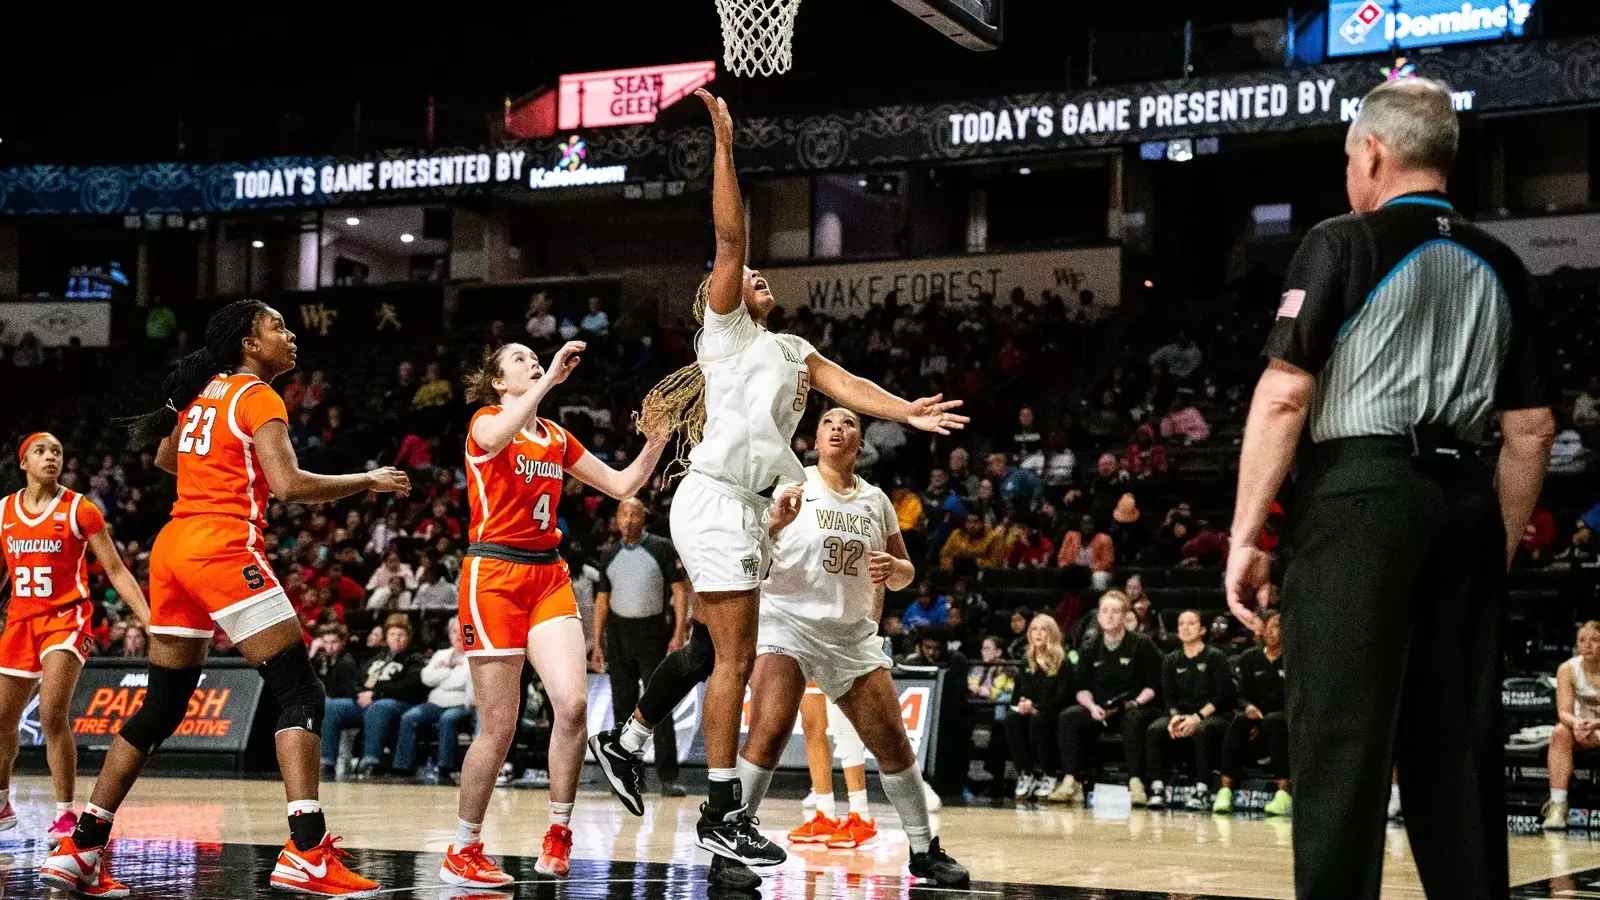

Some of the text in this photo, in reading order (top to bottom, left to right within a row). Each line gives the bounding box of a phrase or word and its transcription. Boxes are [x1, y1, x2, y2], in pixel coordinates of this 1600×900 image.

[1384, 0, 1532, 41] Domino's
[613, 74, 661, 95] SEAT
[610, 97, 659, 117] GEEK
[949, 105, 1054, 145] TODAY'S
[1061, 98, 1131, 136] GAME
[1139, 83, 1288, 129] PRESENTED
[1297, 78, 1337, 115] BY
[233, 151, 525, 200] TODAY'S GAME PRESENTED BY
[807, 268, 1002, 309] WAKE FOREST
[300, 303, 338, 336] WF
[793, 370, 808, 412] 5
[178, 404, 217, 456] 23
[532, 493, 551, 531] 4
[816, 509, 871, 537] WAKE
[7, 535, 62, 560] Syracuse
[822, 536, 865, 577] 32
[15, 566, 53, 598] 25
[242, 564, 266, 591] S
[463, 623, 476, 647] S
[86, 687, 231, 719] PARSH
[72, 717, 109, 735] TIRE
